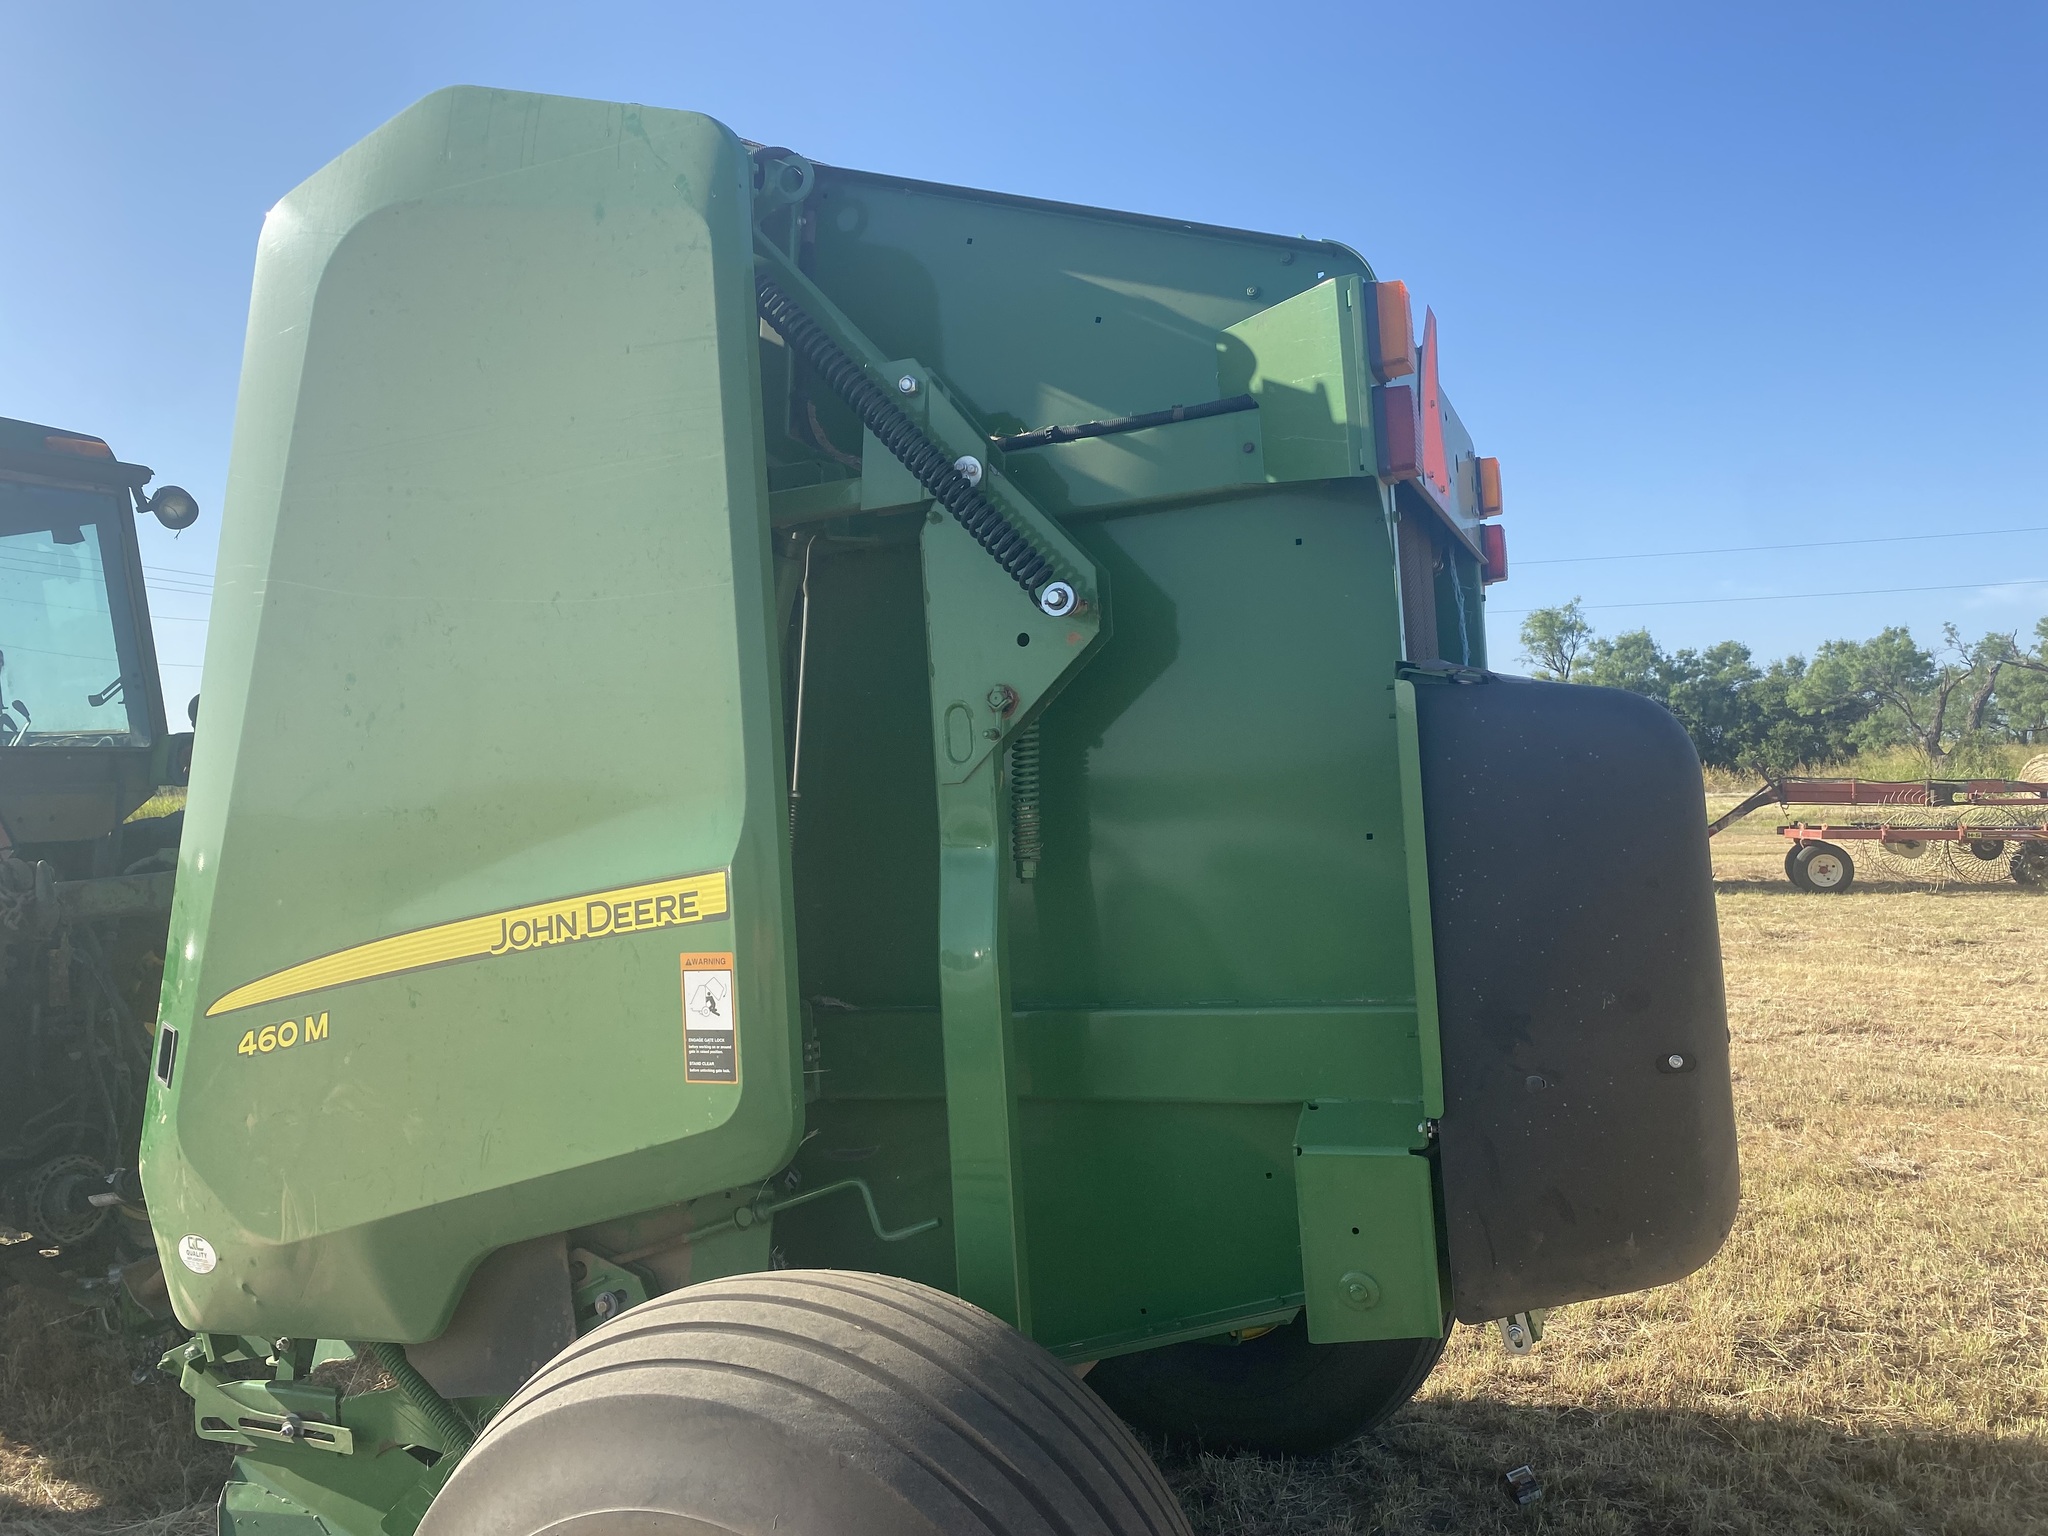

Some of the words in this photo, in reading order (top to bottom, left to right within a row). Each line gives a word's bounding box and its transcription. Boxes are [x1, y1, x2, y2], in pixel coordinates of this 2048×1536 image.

[490, 911, 577, 952] JOHN
[586, 890, 699, 934] DEERE
[691, 957, 726, 965] WARNING
[237, 1019, 299, 1057] 460
[304, 1010, 330, 1043] M
[186, 1249, 207, 1258] QUALITY
